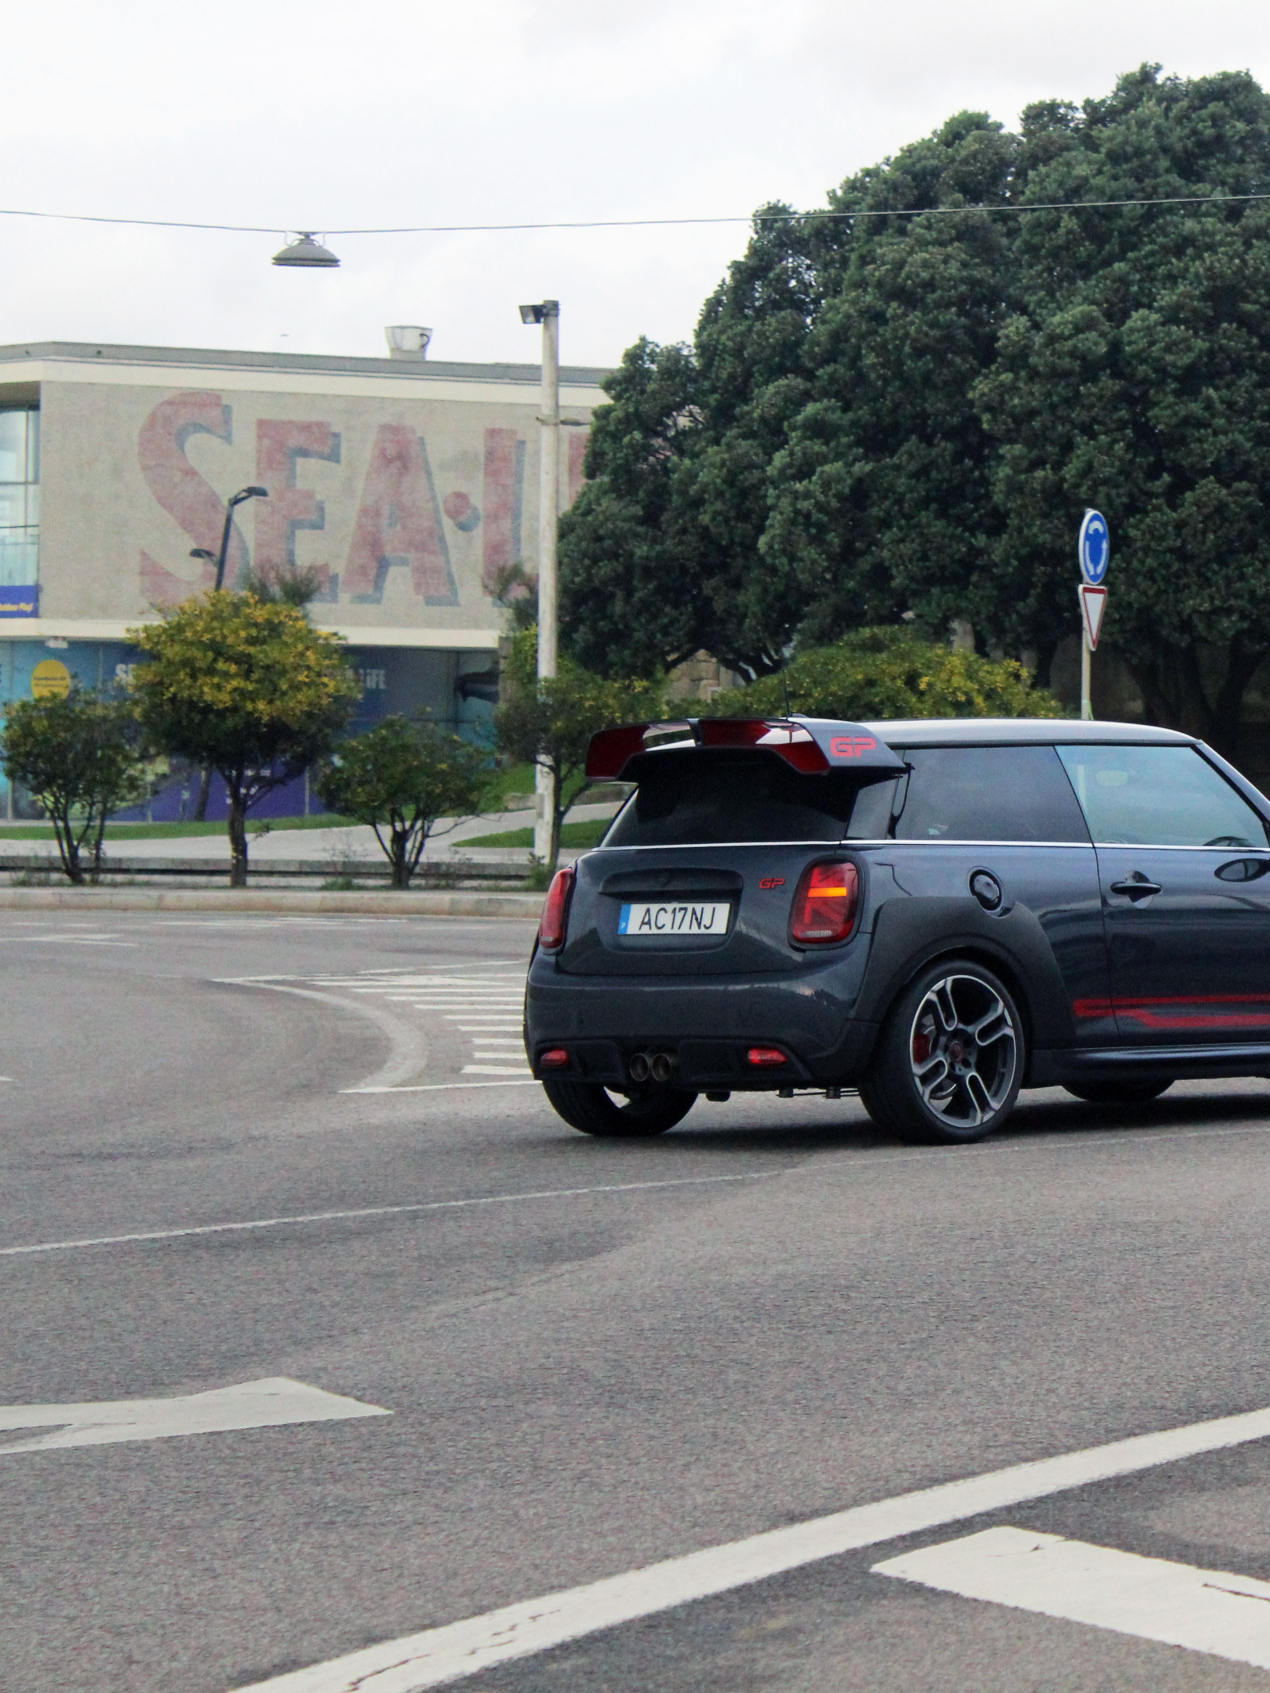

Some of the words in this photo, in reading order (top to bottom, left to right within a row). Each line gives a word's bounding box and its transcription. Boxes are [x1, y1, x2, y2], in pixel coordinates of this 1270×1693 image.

[830, 736, 877, 757] GP
[759, 878, 785, 889] GP
[638, 907, 716, 931] AC17NJ
